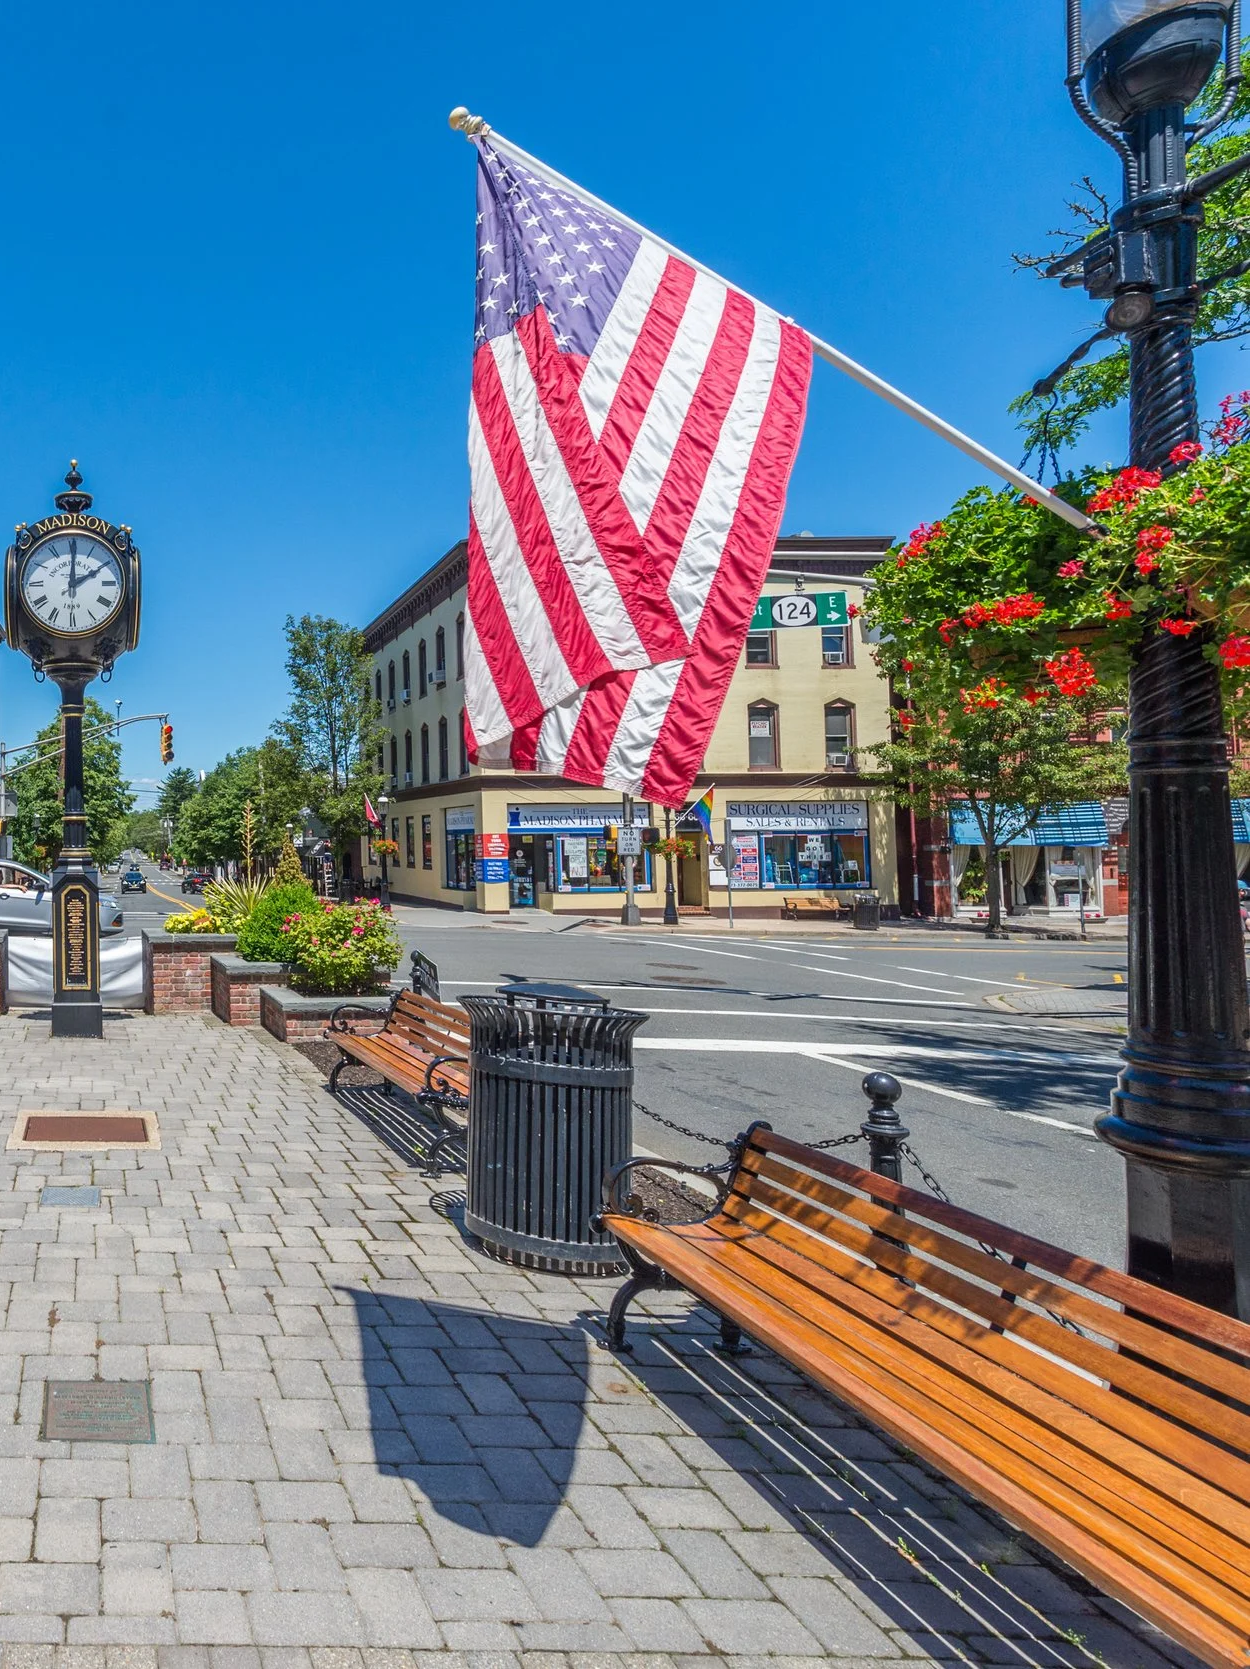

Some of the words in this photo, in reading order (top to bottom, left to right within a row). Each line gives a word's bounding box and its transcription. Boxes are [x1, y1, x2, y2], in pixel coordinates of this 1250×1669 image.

[35, 513, 111, 535] MADISON
[63, 602, 81, 610] 1889
[828, 596, 837, 608] E
[777, 602, 811, 620] 124
[729, 803, 795, 816] SURGICAL
[798, 803, 860, 815] SUPPLIES
[523, 815, 576, 826] MADISON
[578, 815, 647, 826] PHARMY
[746, 817, 782, 828] SALES
[784, 819, 792, 827] &
[796, 816, 846, 827] RENTALS
